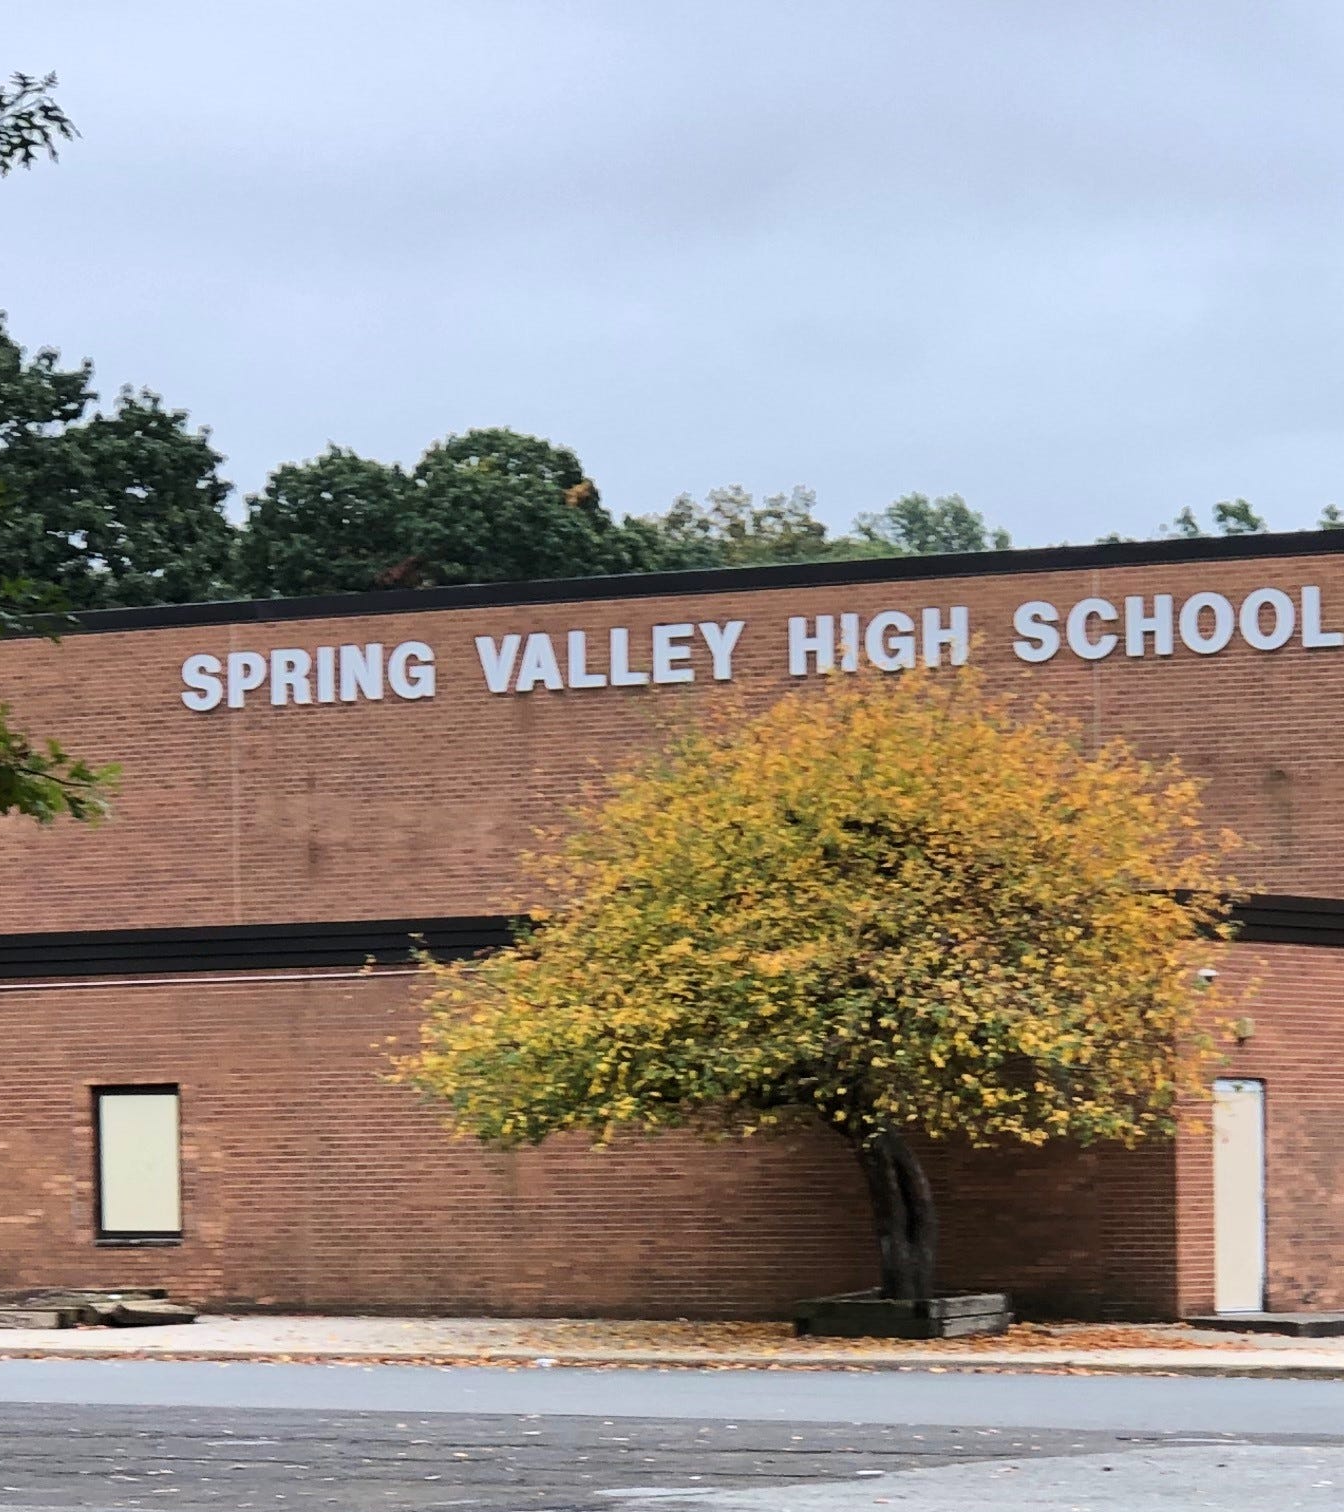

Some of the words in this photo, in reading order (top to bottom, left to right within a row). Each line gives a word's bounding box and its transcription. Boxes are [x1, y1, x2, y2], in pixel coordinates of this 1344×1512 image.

[180, 639, 437, 712] SPRING
[474, 620, 746, 694] VALLEY
[787, 605, 969, 676] HIGH
[1012, 585, 1344, 662] SCHOOL
